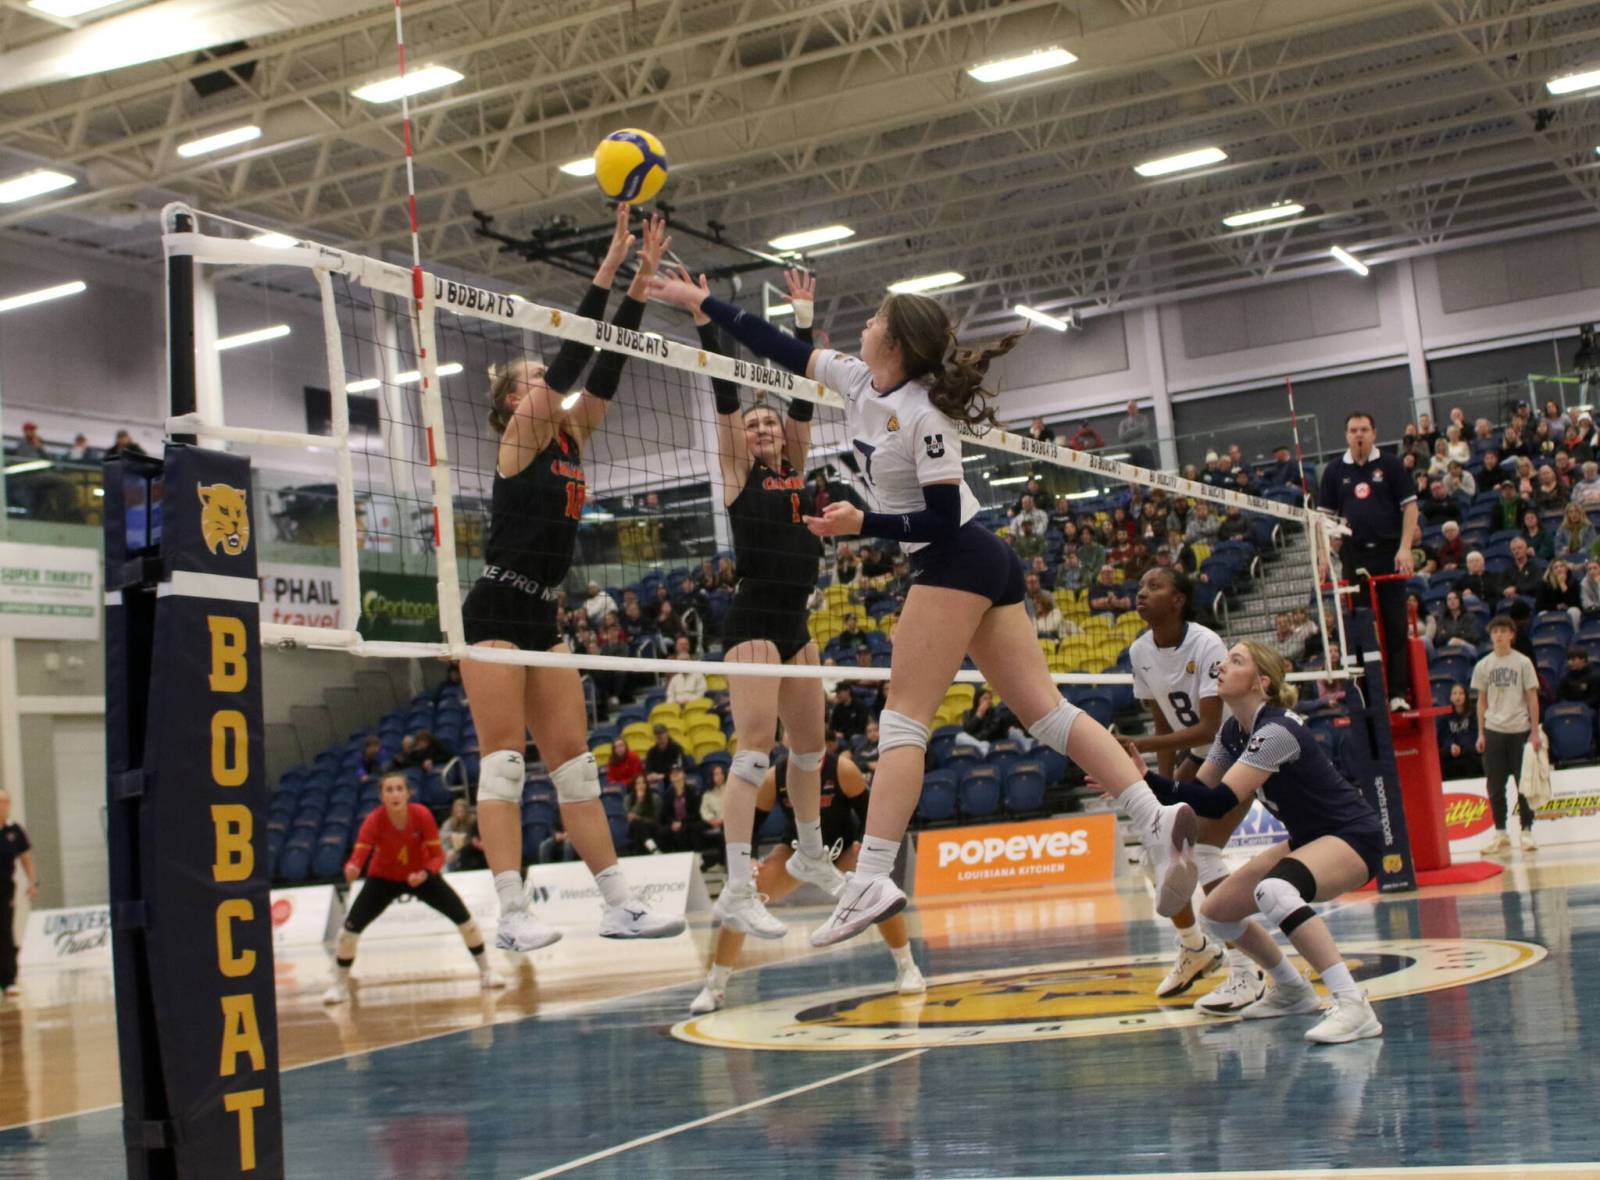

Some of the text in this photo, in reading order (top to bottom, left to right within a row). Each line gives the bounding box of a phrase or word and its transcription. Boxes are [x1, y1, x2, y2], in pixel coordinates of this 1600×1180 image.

[434, 278, 515, 318] U BOBCATS
[595, 320, 669, 359] BU BOBCATS
[734, 359, 748, 380] BU
[853, 438, 876, 487] 7
[500, 568, 539, 595] PRO
[272, 606, 341, 629] travel
[1168, 690, 1200, 728] 8
[397, 845, 409, 866] 4
[957, 862, 1066, 881] LOUISIANA KITCHEN
